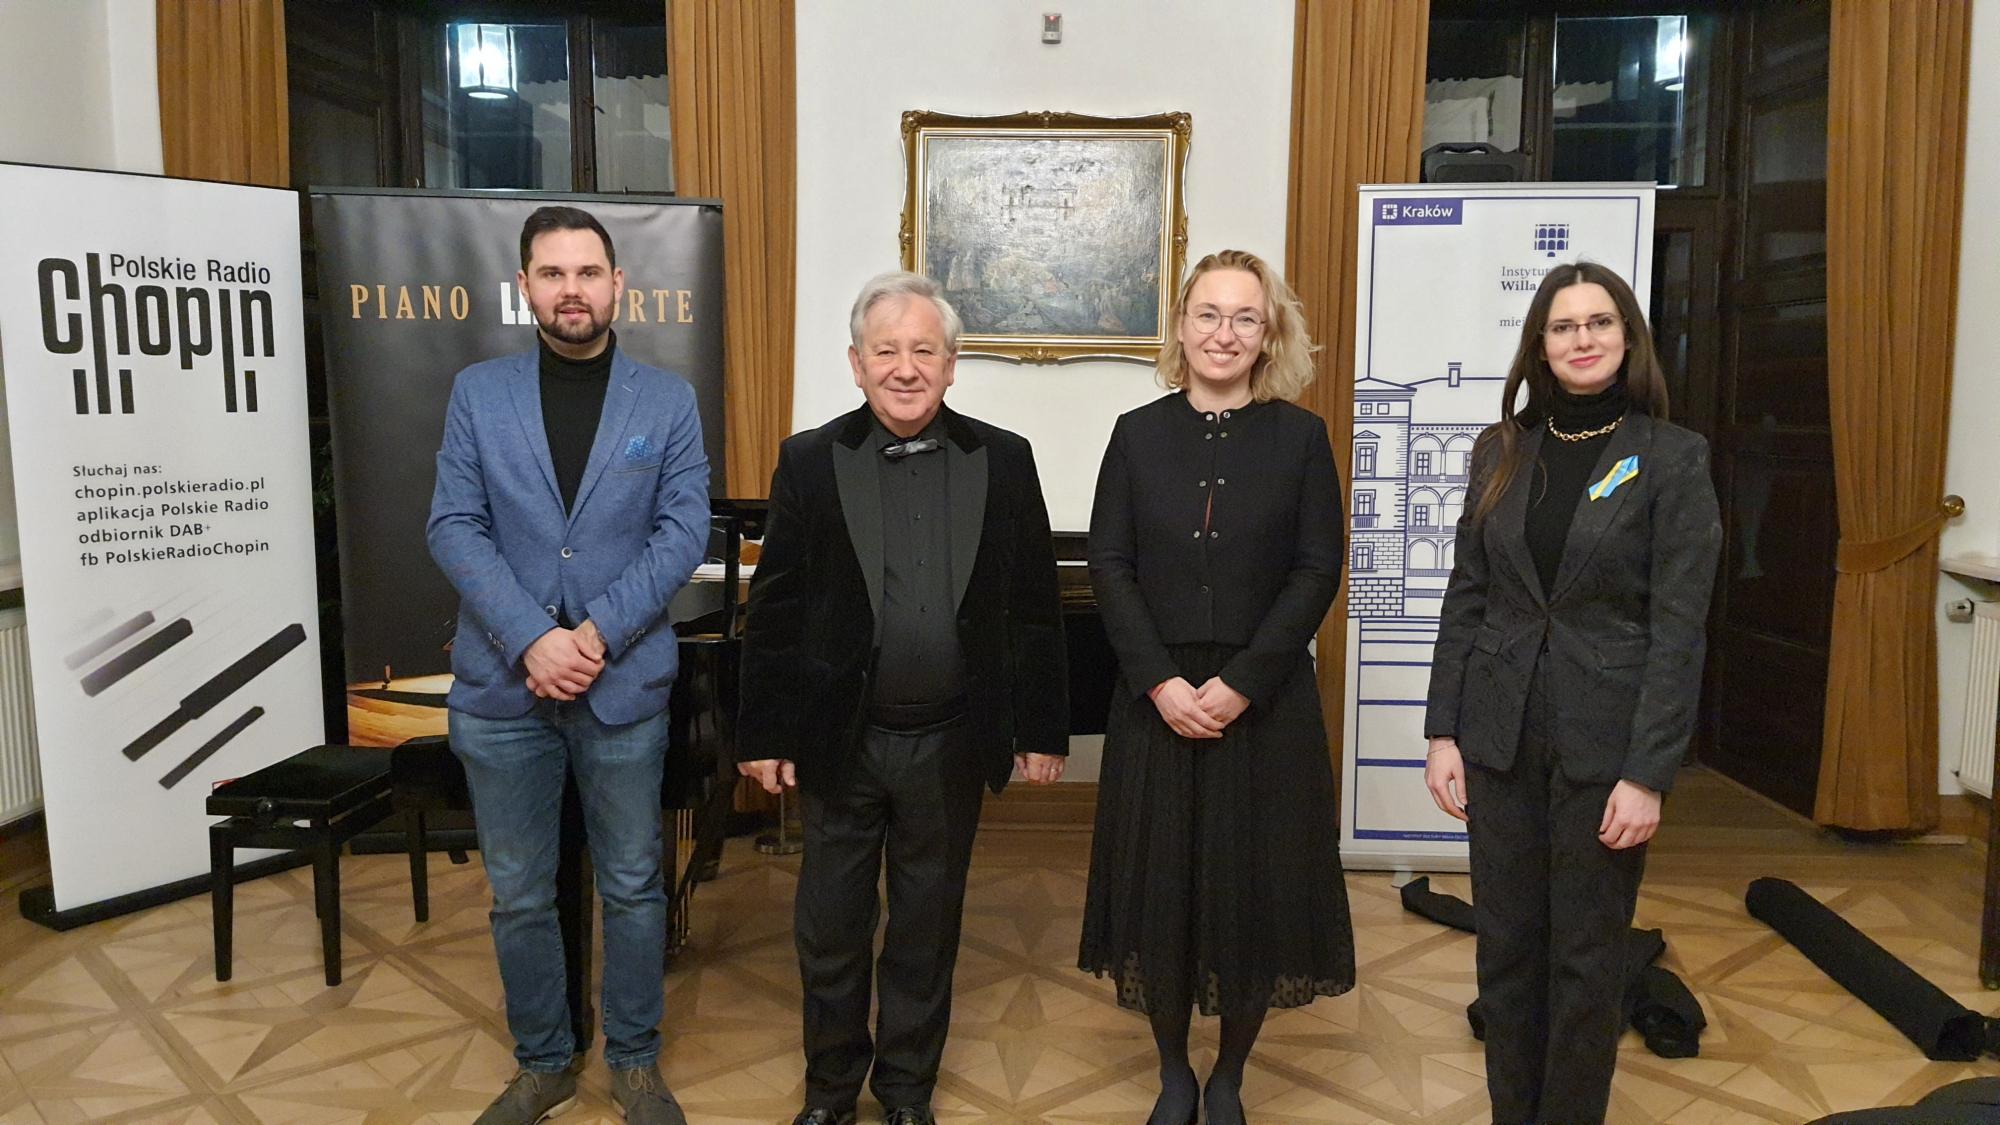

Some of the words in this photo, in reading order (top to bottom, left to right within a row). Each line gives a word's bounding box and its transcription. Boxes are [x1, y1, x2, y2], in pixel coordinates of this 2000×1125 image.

[1402, 203, 1453, 218] Kraków
[110, 253, 196, 281] Polskie
[206, 259, 271, 284] Radio
[1501, 280, 1537, 291] Willa
[350, 284, 469, 320] PIANO
[38, 252, 275, 415] Chopin
[133, 464, 163, 475] nas:
[74, 477, 266, 501] chopin.polskieradio.pl
[76, 506, 155, 525] aplikacja
[161, 500, 219, 517] Polskie
[225, 498, 270, 513] Radio
[78, 525, 165, 545] odbiornik
[170, 523, 212, 538] DAB+
[80, 552, 99, 567] fb
[105, 539, 270, 565] PolskieRadioChopin
